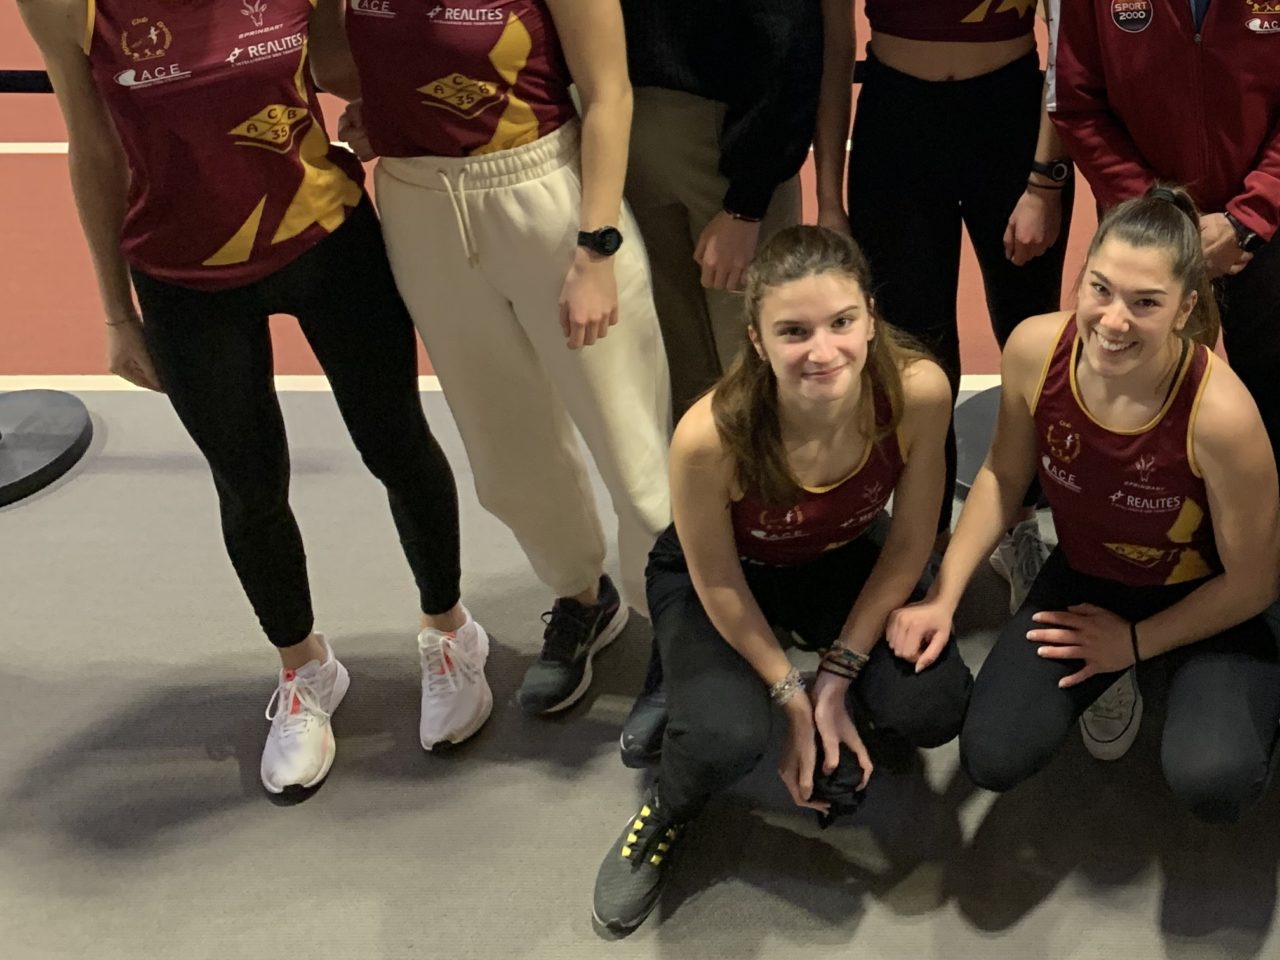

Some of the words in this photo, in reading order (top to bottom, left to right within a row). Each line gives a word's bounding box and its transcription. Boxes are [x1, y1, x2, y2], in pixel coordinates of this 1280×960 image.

[361, 0, 390, 12] ACE
[1114, 1, 1148, 12] SPORT
[444, 7, 503, 21] REALITES
[1118, 10, 1146, 21] 2000
[247, 32, 303, 58] REALITES
[140, 63, 181, 81] ACE
[1051, 465, 1077, 484] ACE
[1126, 495, 1181, 509] REALITES
